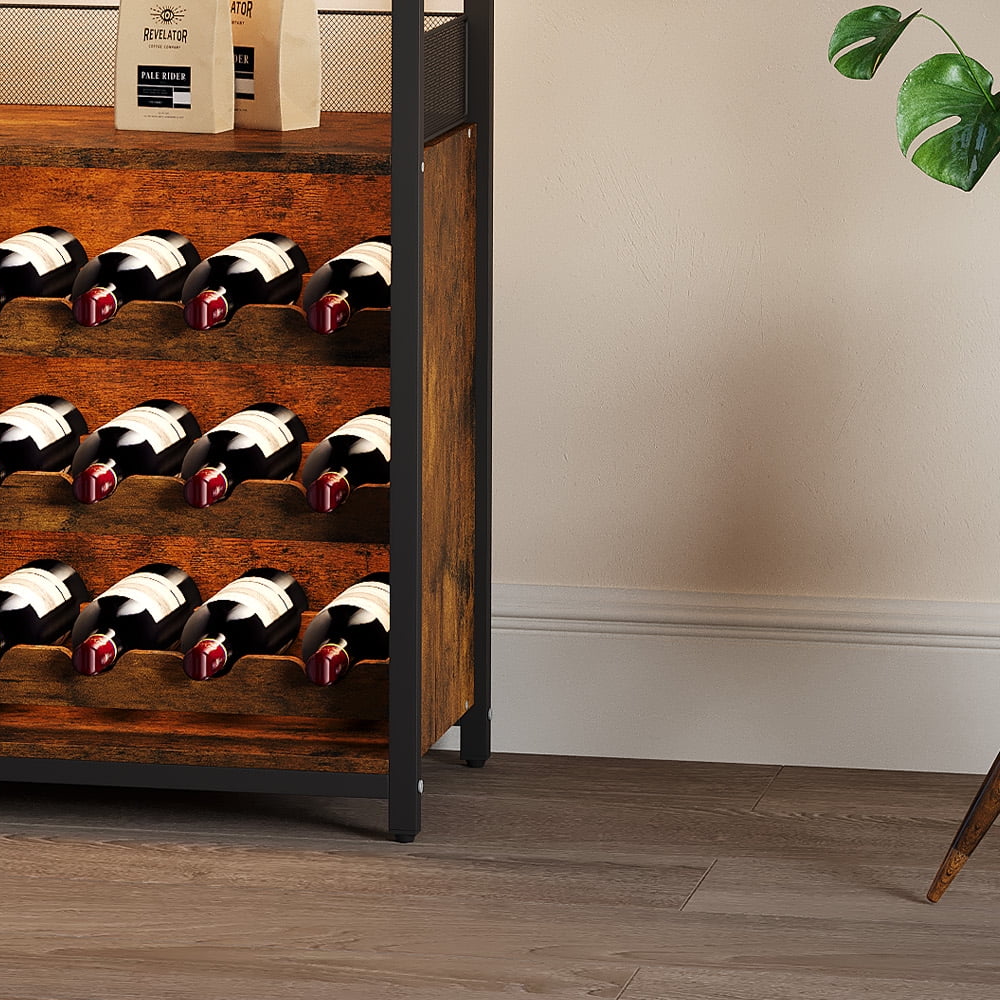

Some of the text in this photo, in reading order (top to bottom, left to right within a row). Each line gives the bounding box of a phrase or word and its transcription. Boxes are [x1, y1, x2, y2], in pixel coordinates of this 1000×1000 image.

[143, 27, 188, 44] REVELATOR
[141, 71, 187, 81] PALE RIDER
